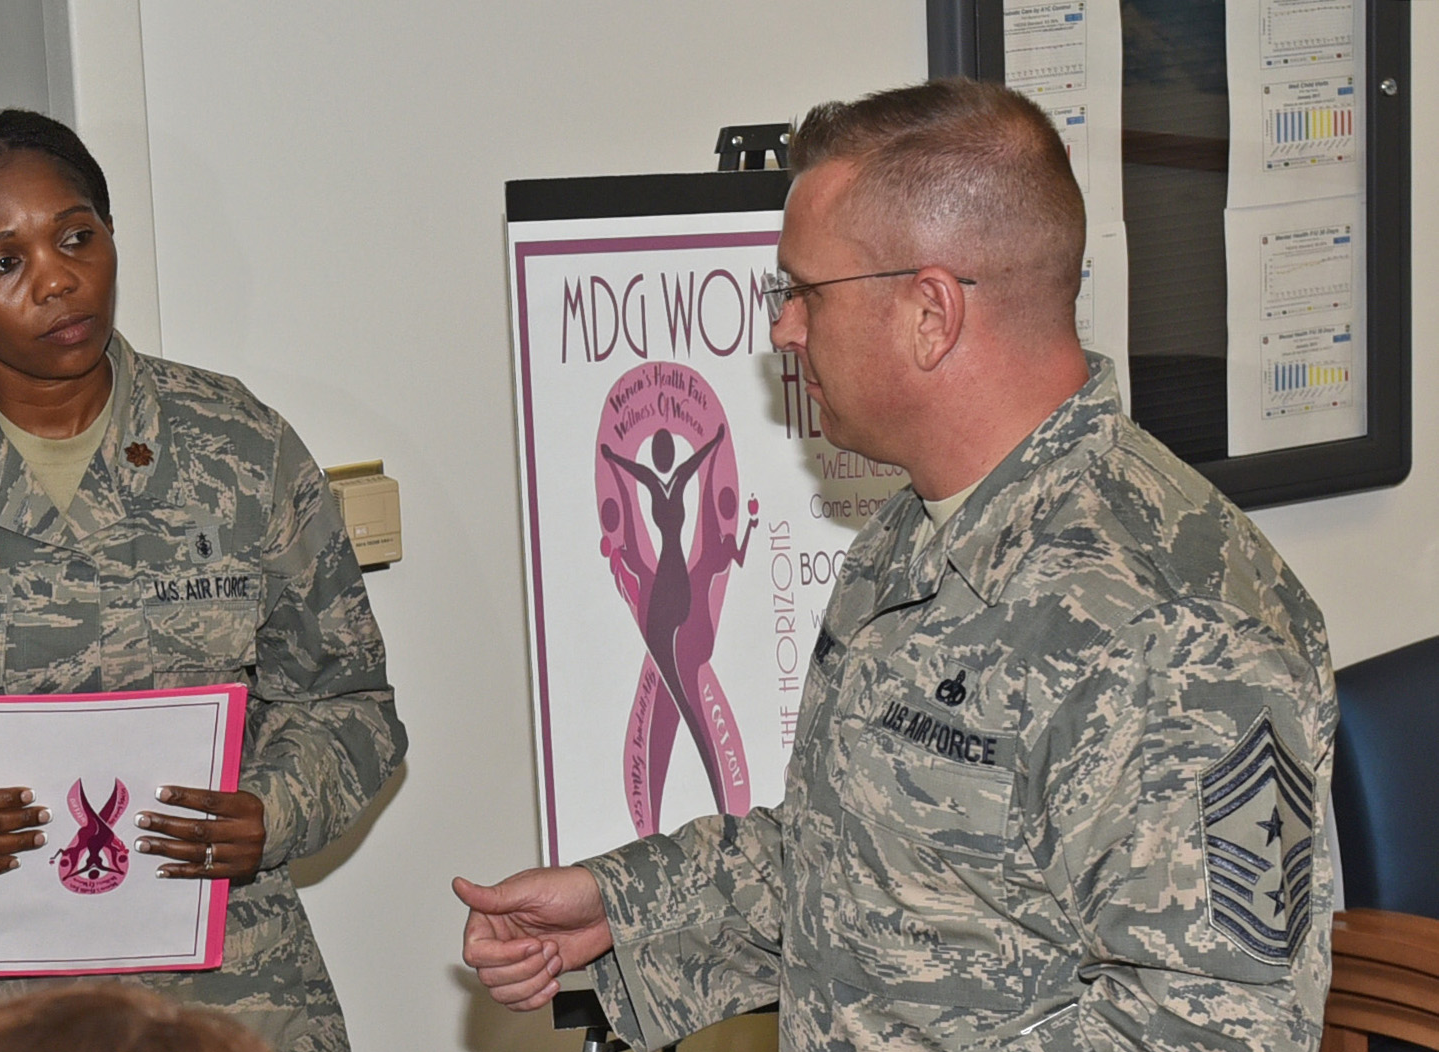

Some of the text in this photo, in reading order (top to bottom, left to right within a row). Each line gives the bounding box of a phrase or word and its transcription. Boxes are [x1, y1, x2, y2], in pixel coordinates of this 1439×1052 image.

[562, 275, 648, 364] MDG
[609, 363, 707, 414] Women's Health Fair
[614, 403, 655, 440] Wellness
[671, 396, 704, 437] Women
[810, 494, 852, 519] Come
[154, 576, 249, 602] U.S. AIR FORCE
[769, 519, 799, 692] HORIZONS
[703, 683, 714, 702] 17
[725, 746, 744, 787] 2017
[904, 712, 933, 744] AIR
[925, 720, 997, 765] FORCE
[631, 754, 647, 796] MDG
